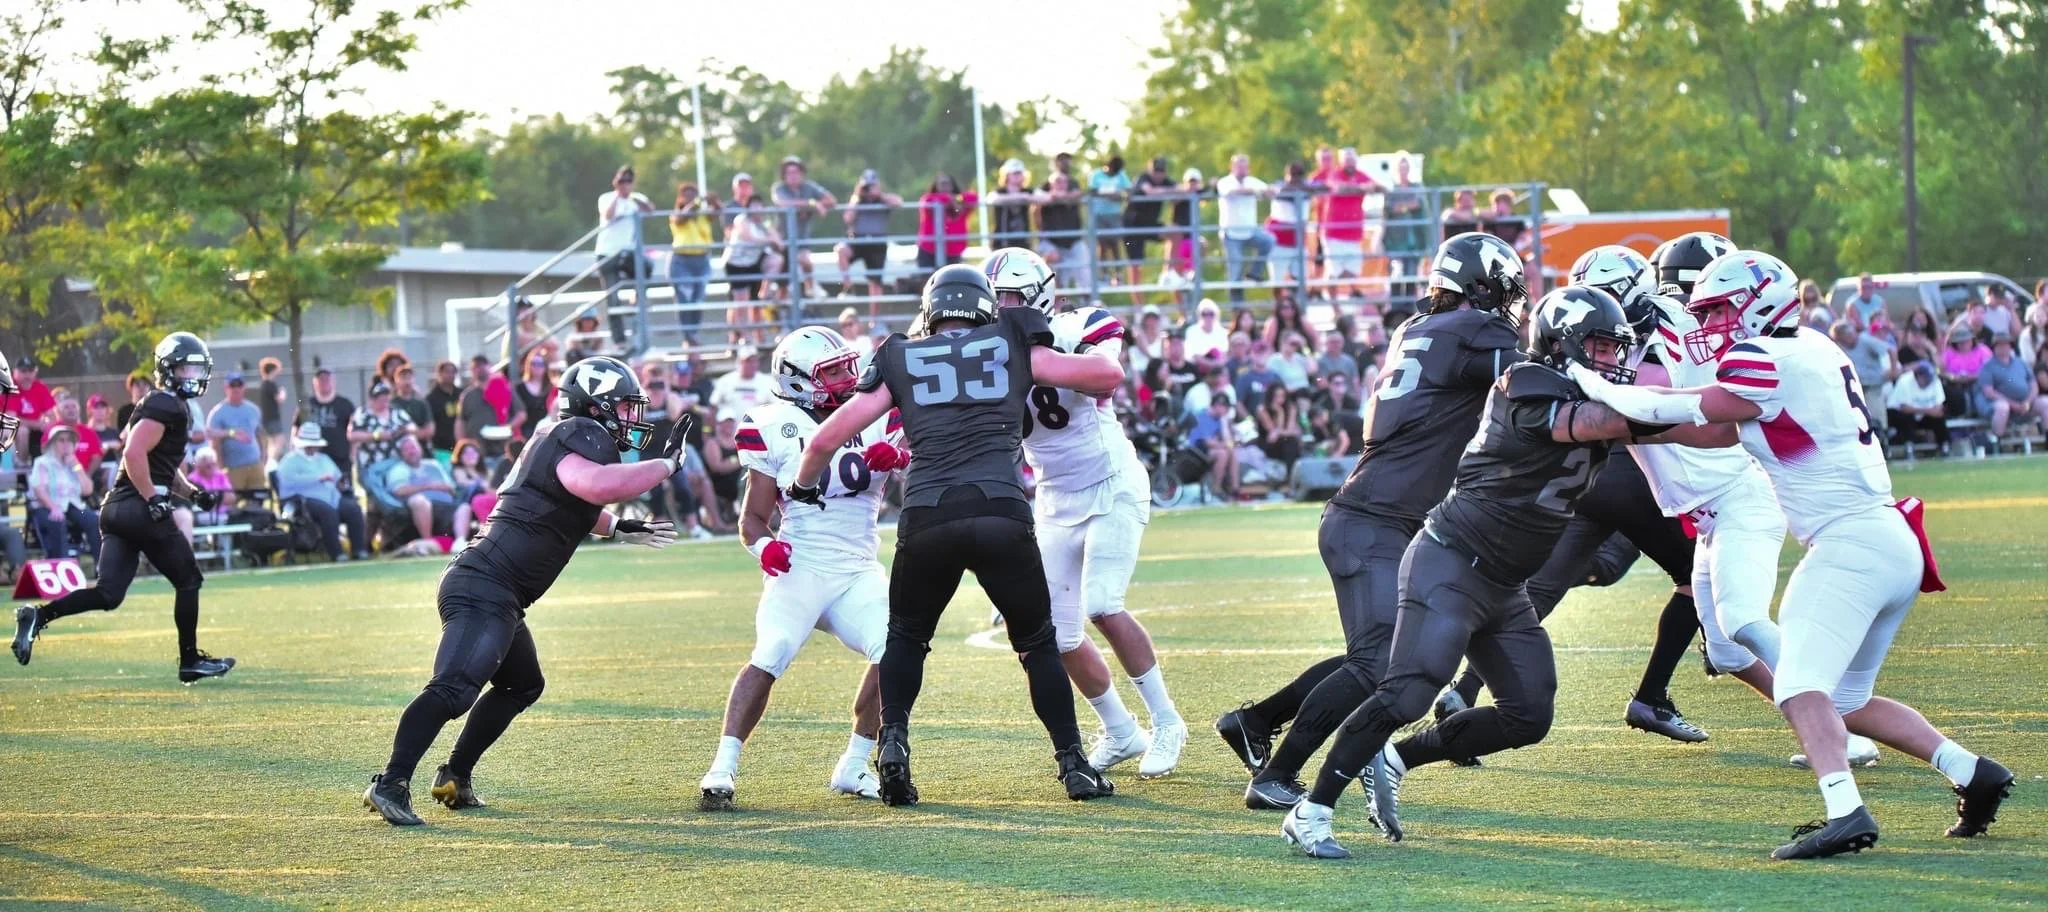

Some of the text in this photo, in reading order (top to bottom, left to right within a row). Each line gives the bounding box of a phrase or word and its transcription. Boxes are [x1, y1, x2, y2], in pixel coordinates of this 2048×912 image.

[942, 309, 976, 319] Riddell
[905, 336, 1010, 406] 53
[31, 561, 87, 594] 50
